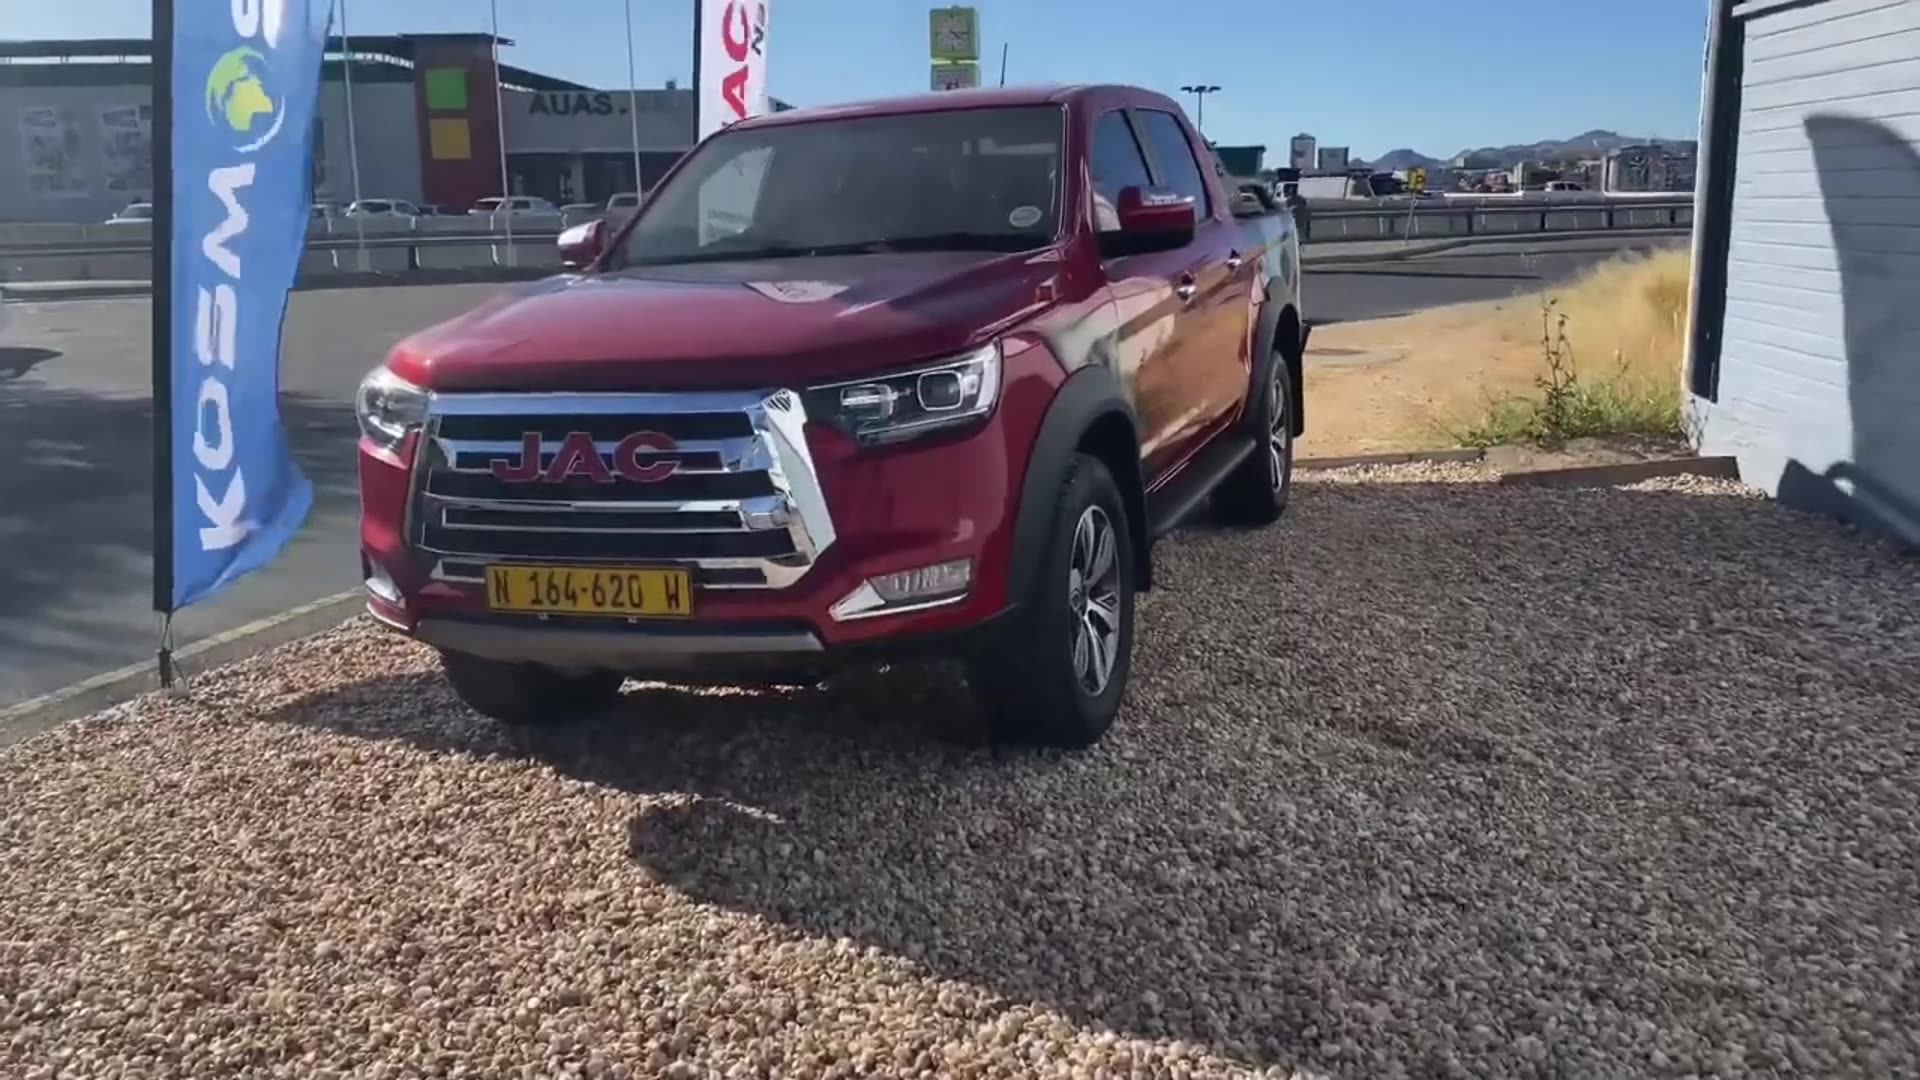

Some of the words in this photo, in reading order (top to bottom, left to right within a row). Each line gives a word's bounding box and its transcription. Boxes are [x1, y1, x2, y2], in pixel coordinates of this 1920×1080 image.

[721, 1, 749, 126] AC
[489, 431, 681, 483] JAC
[494, 569, 511, 604] N
[528, 571, 643, 609] 164-620
[664, 575, 680, 609] W
